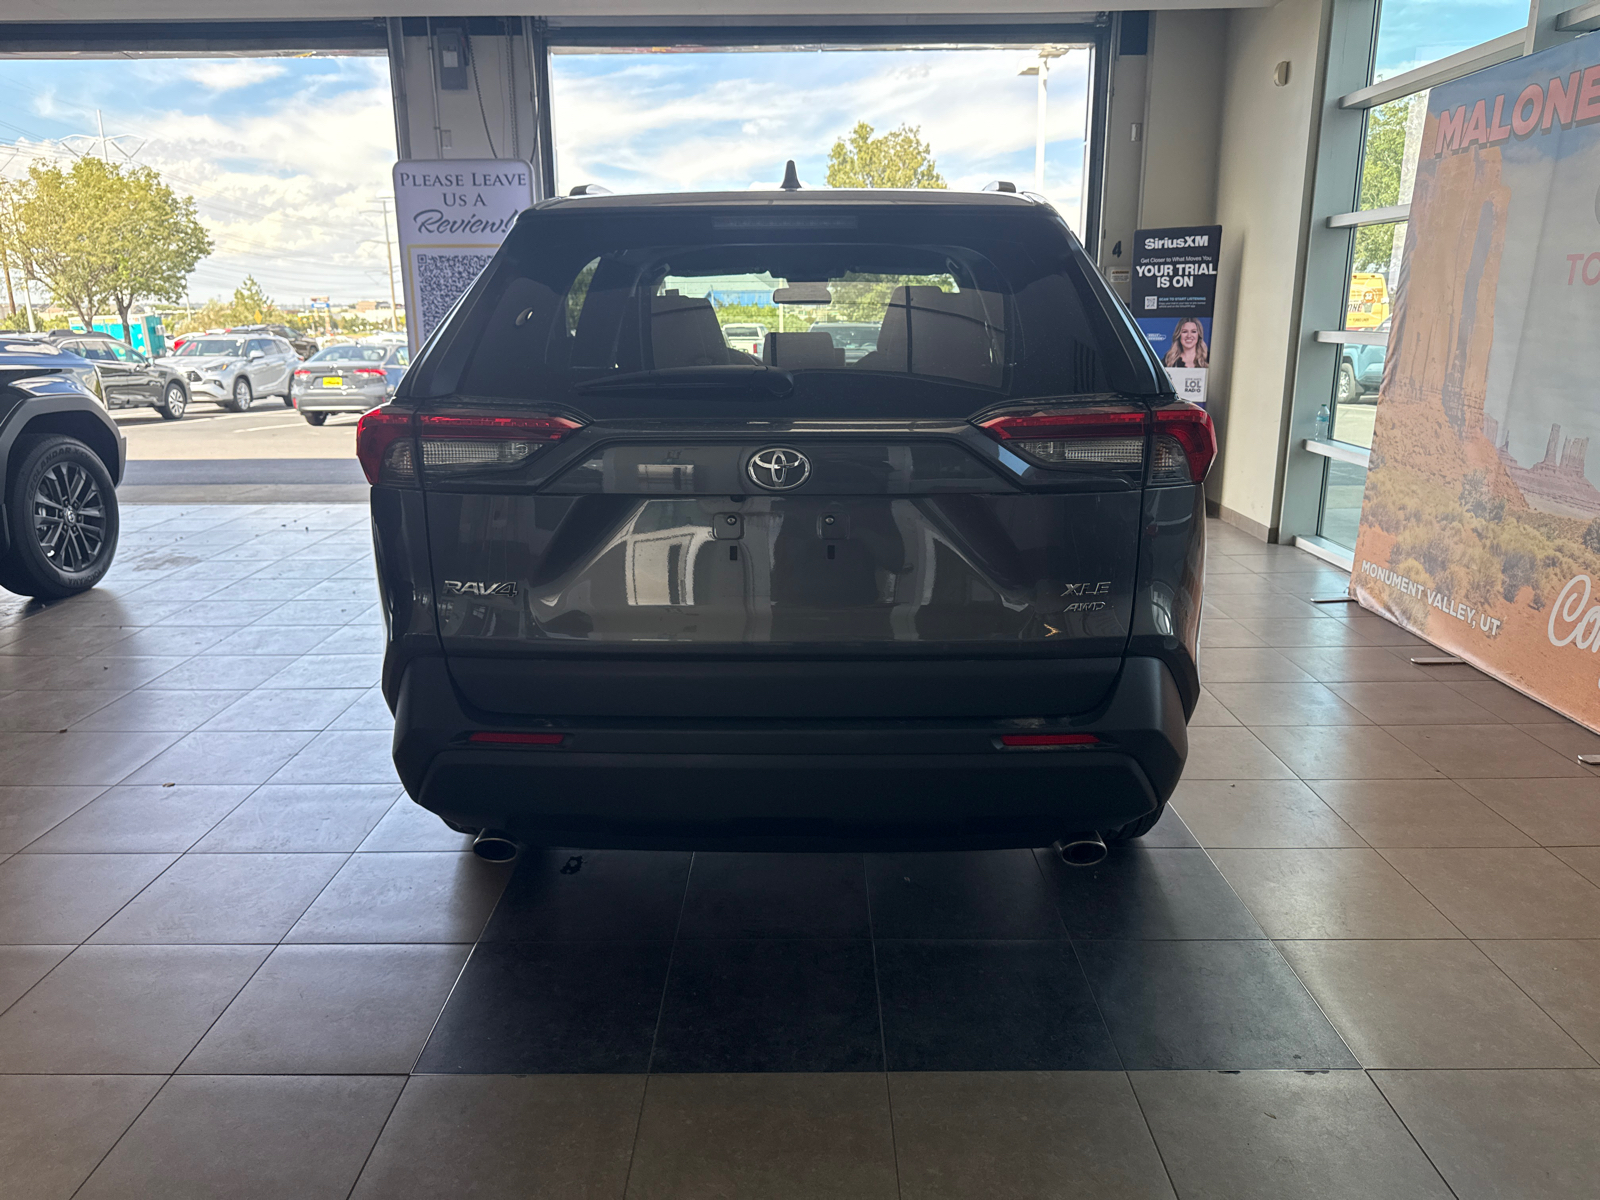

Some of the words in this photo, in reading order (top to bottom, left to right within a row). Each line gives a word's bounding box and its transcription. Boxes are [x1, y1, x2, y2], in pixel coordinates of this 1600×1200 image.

[1434, 64, 1600, 159] MALONE
[399, 172, 465, 187] PLEASE
[471, 172, 527, 187] LEAVE
[442, 192, 467, 208] US
[473, 192, 488, 207] A
[413, 209, 518, 234] Review!
[1112, 240, 1122, 258] 4
[1144, 235, 1209, 250] SiriusXM
[1135, 264, 1174, 277] YOUR
[1176, 263, 1217, 275] TRIAL
[1156, 276, 1170, 288] IS
[1172, 276, 1194, 288] ON
[1184, 380, 1202, 388] LOL
[442, 580, 518, 598] RAV4
[1060, 581, 1111, 597] XLE
[1361, 559, 1425, 600] MONUMENT
[1427, 588, 1477, 629] VALLEY,
[1479, 614, 1501, 636] UT
[1063, 601, 1106, 613] AWD
